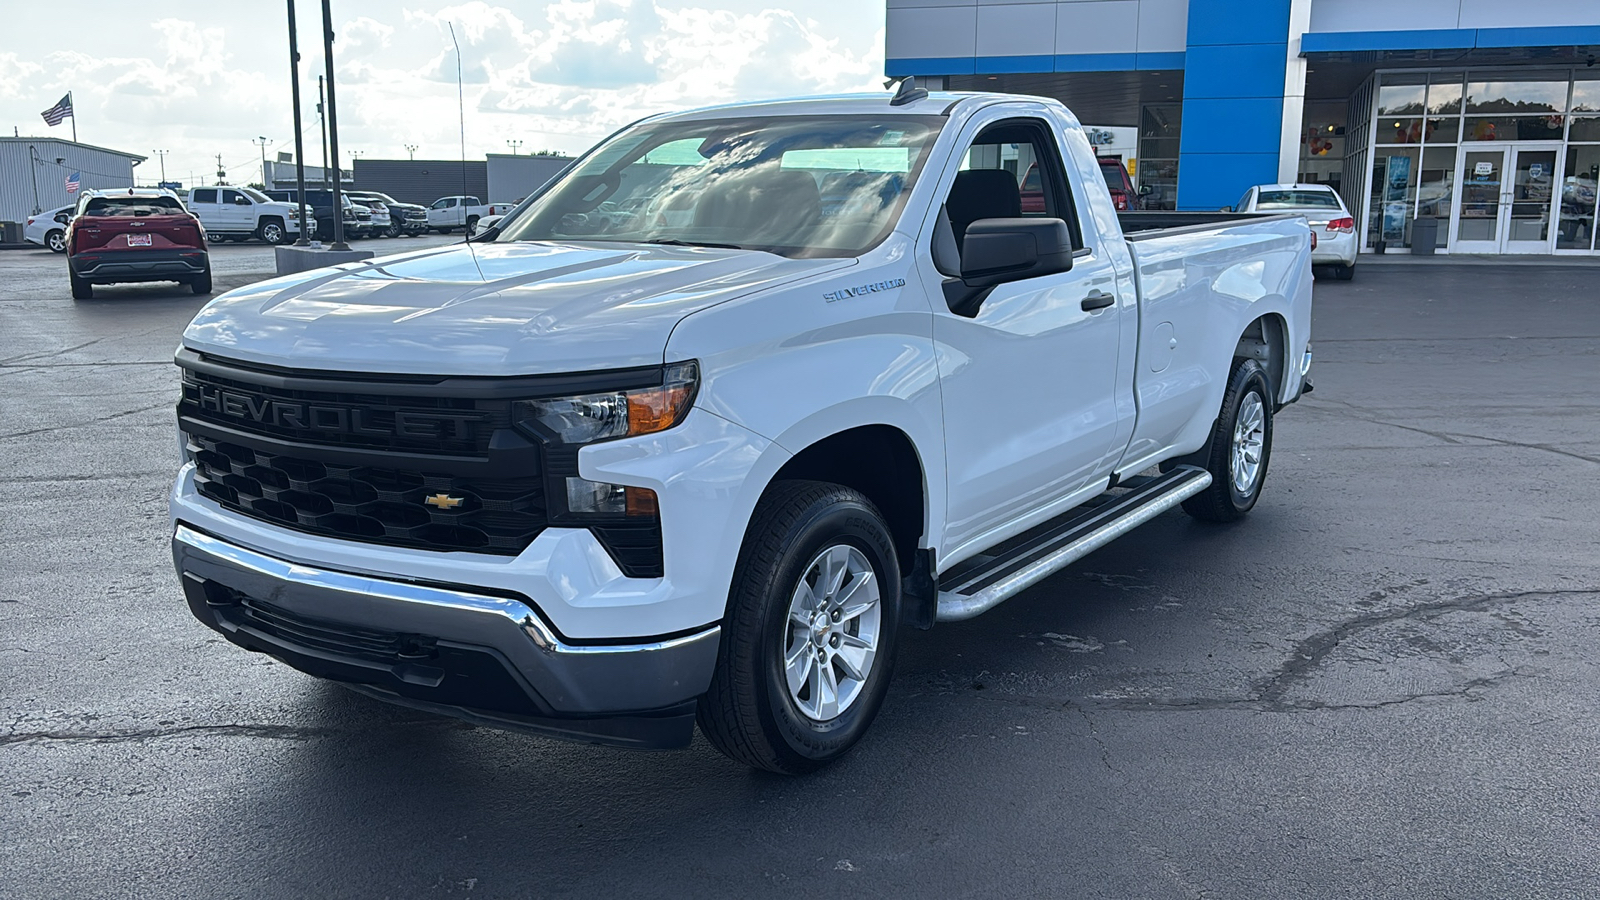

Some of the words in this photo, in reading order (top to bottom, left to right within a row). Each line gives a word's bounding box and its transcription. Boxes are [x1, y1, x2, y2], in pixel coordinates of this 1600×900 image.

[823, 278, 906, 303] SILVERADO
[181, 380, 484, 440] CHEVROLET
[845, 517, 890, 560] GENERAL
